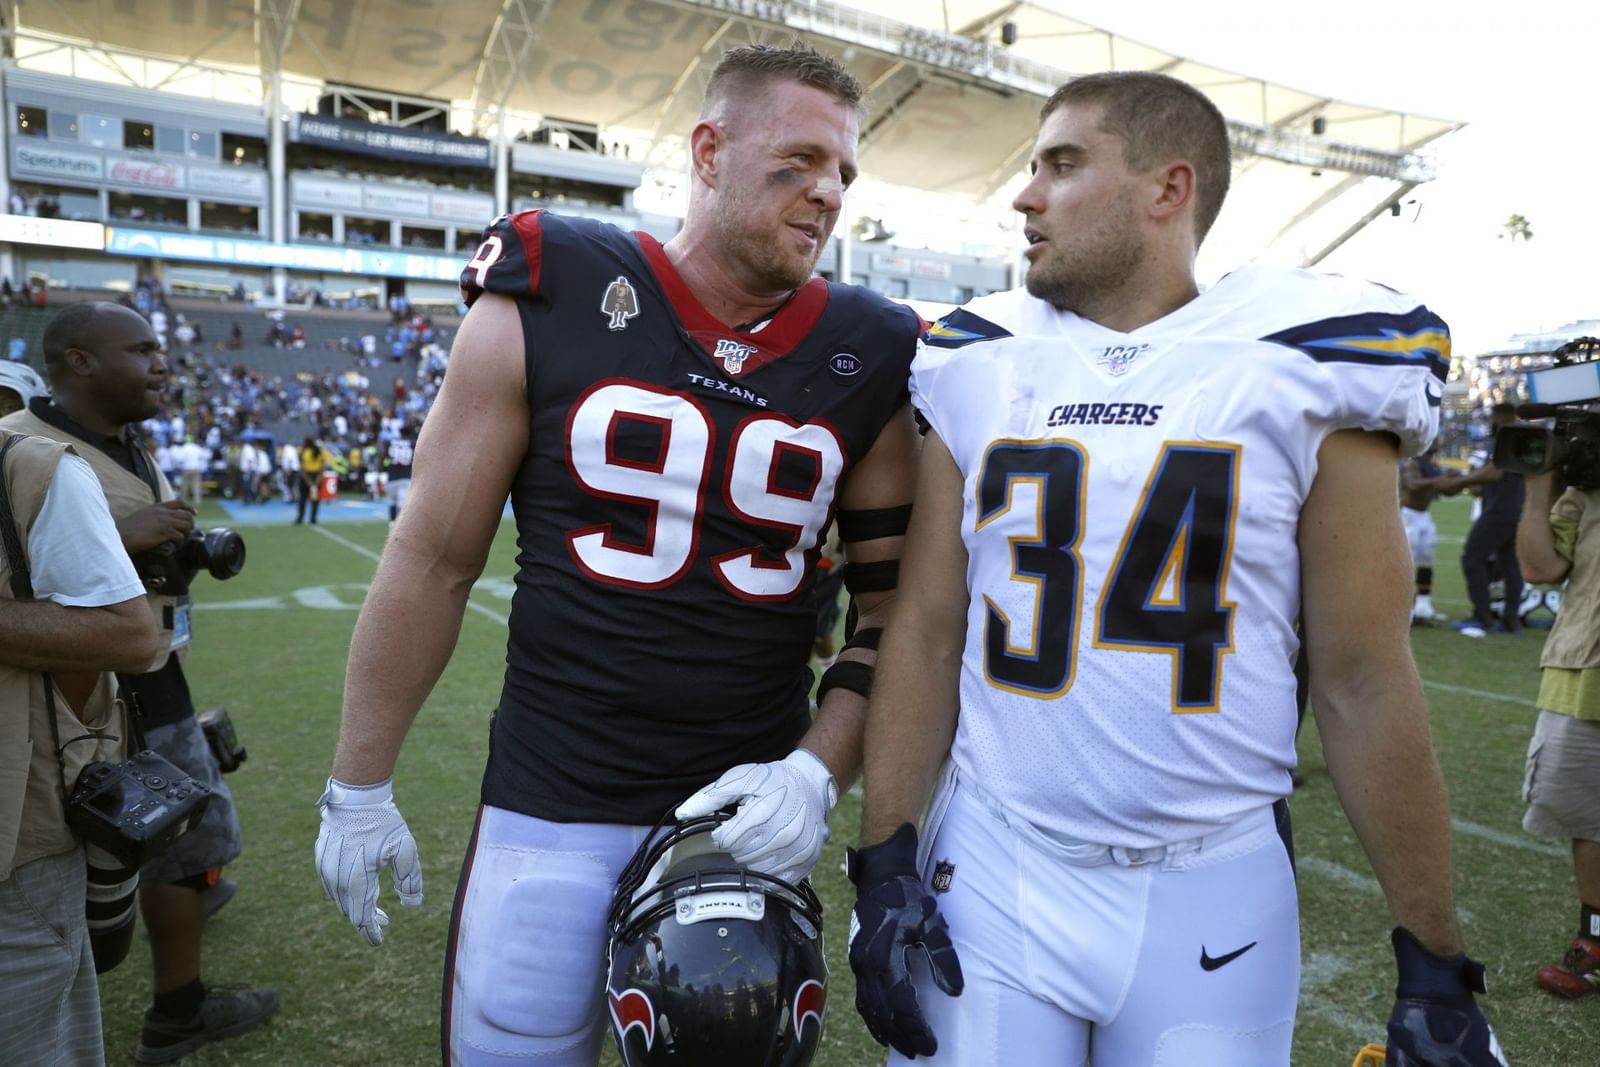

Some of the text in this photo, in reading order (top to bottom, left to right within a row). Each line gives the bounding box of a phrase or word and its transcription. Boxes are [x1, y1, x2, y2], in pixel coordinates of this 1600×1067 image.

[18, 148, 97, 173] Spectrum
[687, 373, 769, 407] TEXANS
[1046, 402, 1164, 427] CHARGERS
[565, 377, 849, 603] 99
[975, 437, 1243, 714] 34
